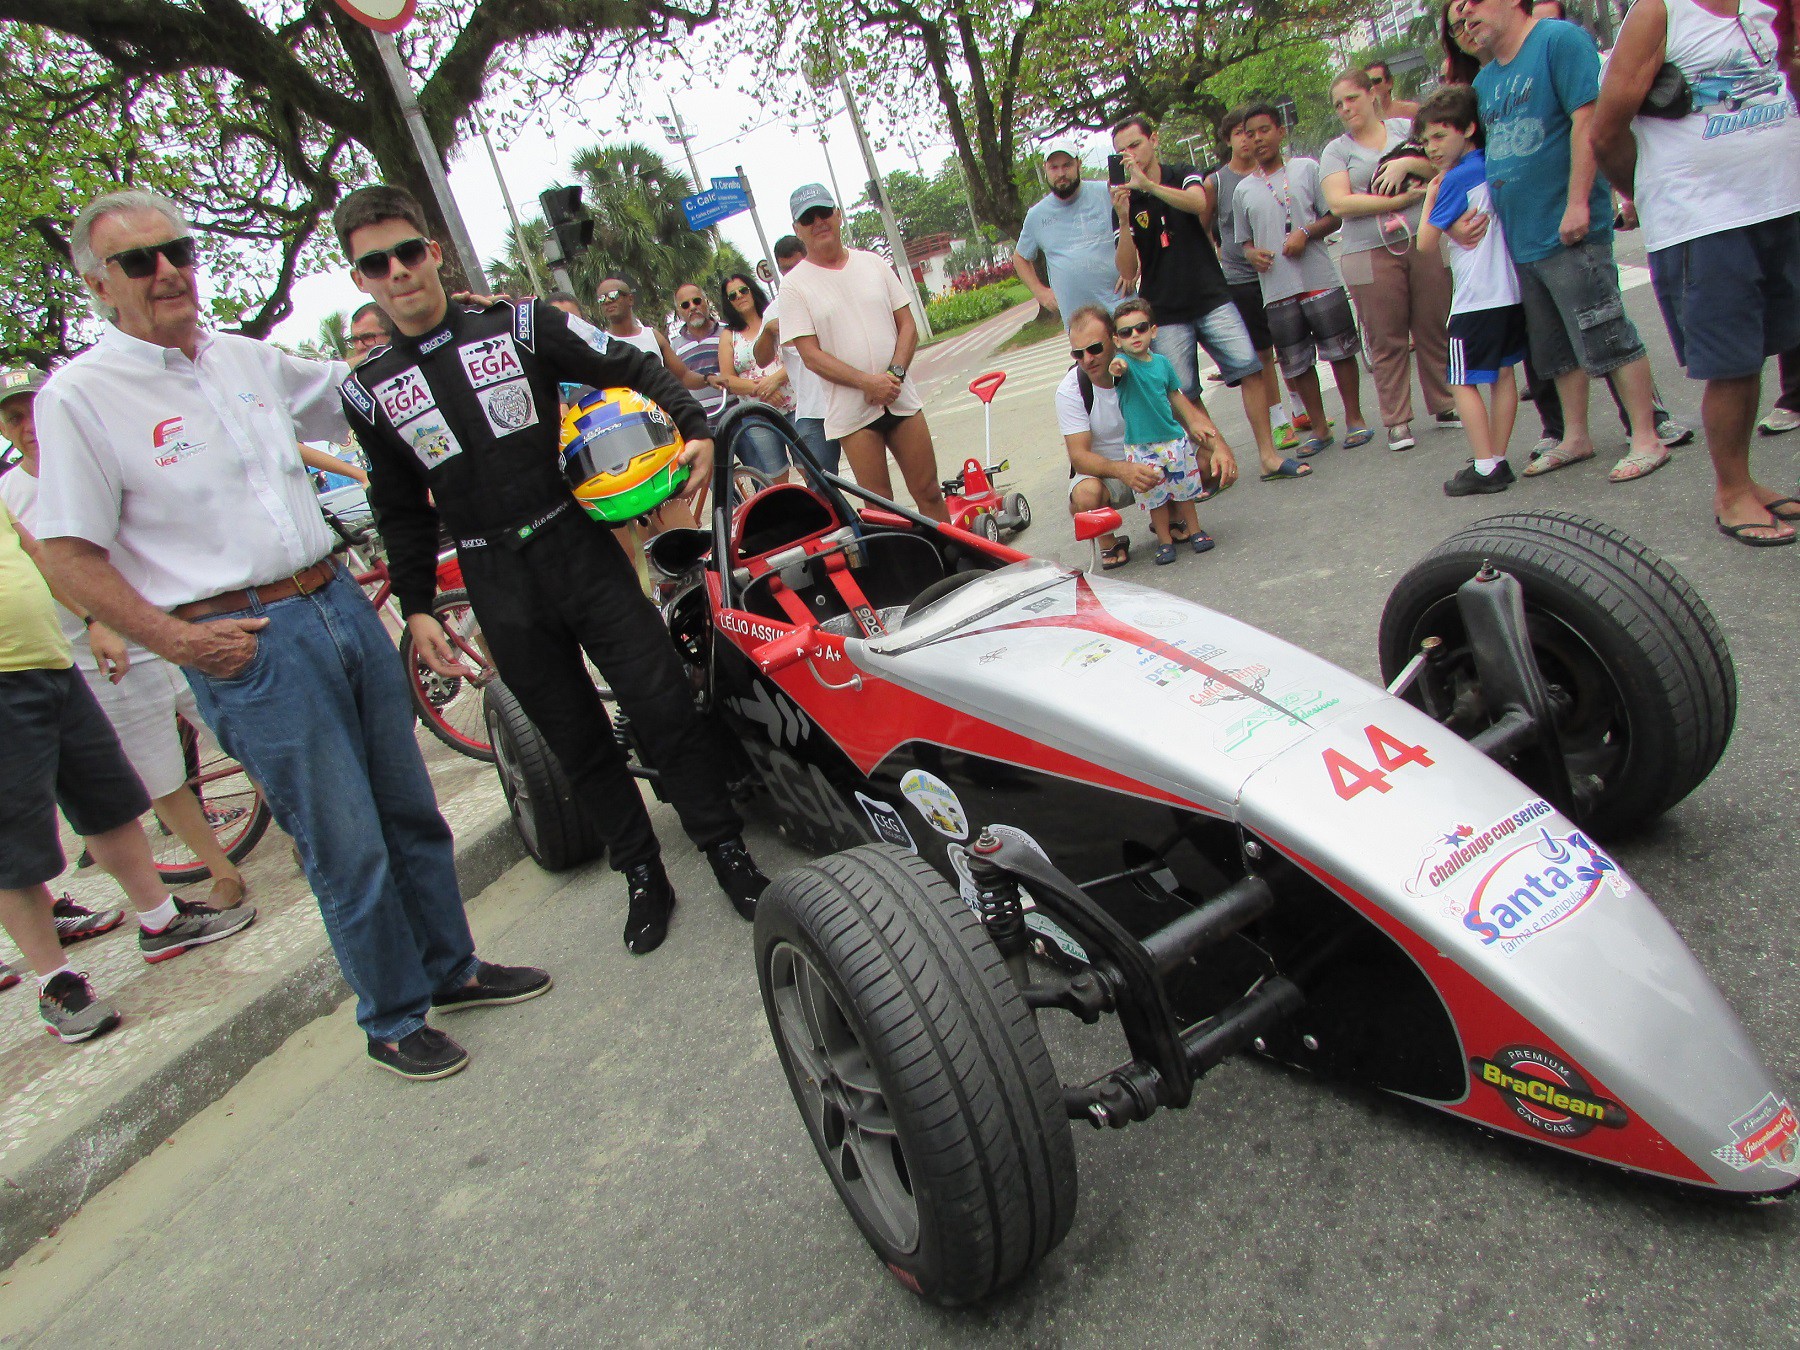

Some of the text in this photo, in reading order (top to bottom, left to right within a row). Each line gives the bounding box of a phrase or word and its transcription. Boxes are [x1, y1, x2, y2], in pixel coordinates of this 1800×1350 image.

[518, 303, 530, 340] sparco
[418, 330, 453, 355] sparco
[468, 350, 518, 381] EGA
[343, 380, 371, 412] sparco
[384, 384, 429, 420] EGA
[720, 612, 749, 635] LÉLIO
[1188, 662, 1267, 705] CARLO REITAS
[1321, 723, 1437, 803] 44
[740, 738, 873, 844] EGA
[873, 812, 900, 831] CEG
[1428, 829, 1495, 888] challenge
[1512, 798, 1551, 827] series
[1463, 865, 1575, 946] Santa
[1501, 927, 1533, 955] farma
[1532, 920, 1542, 932] e
[1508, 1049, 1571, 1077] PREMIUM
[1482, 1062, 1606, 1121] BraClean
[1516, 1106, 1576, 1134] CAR CARE
